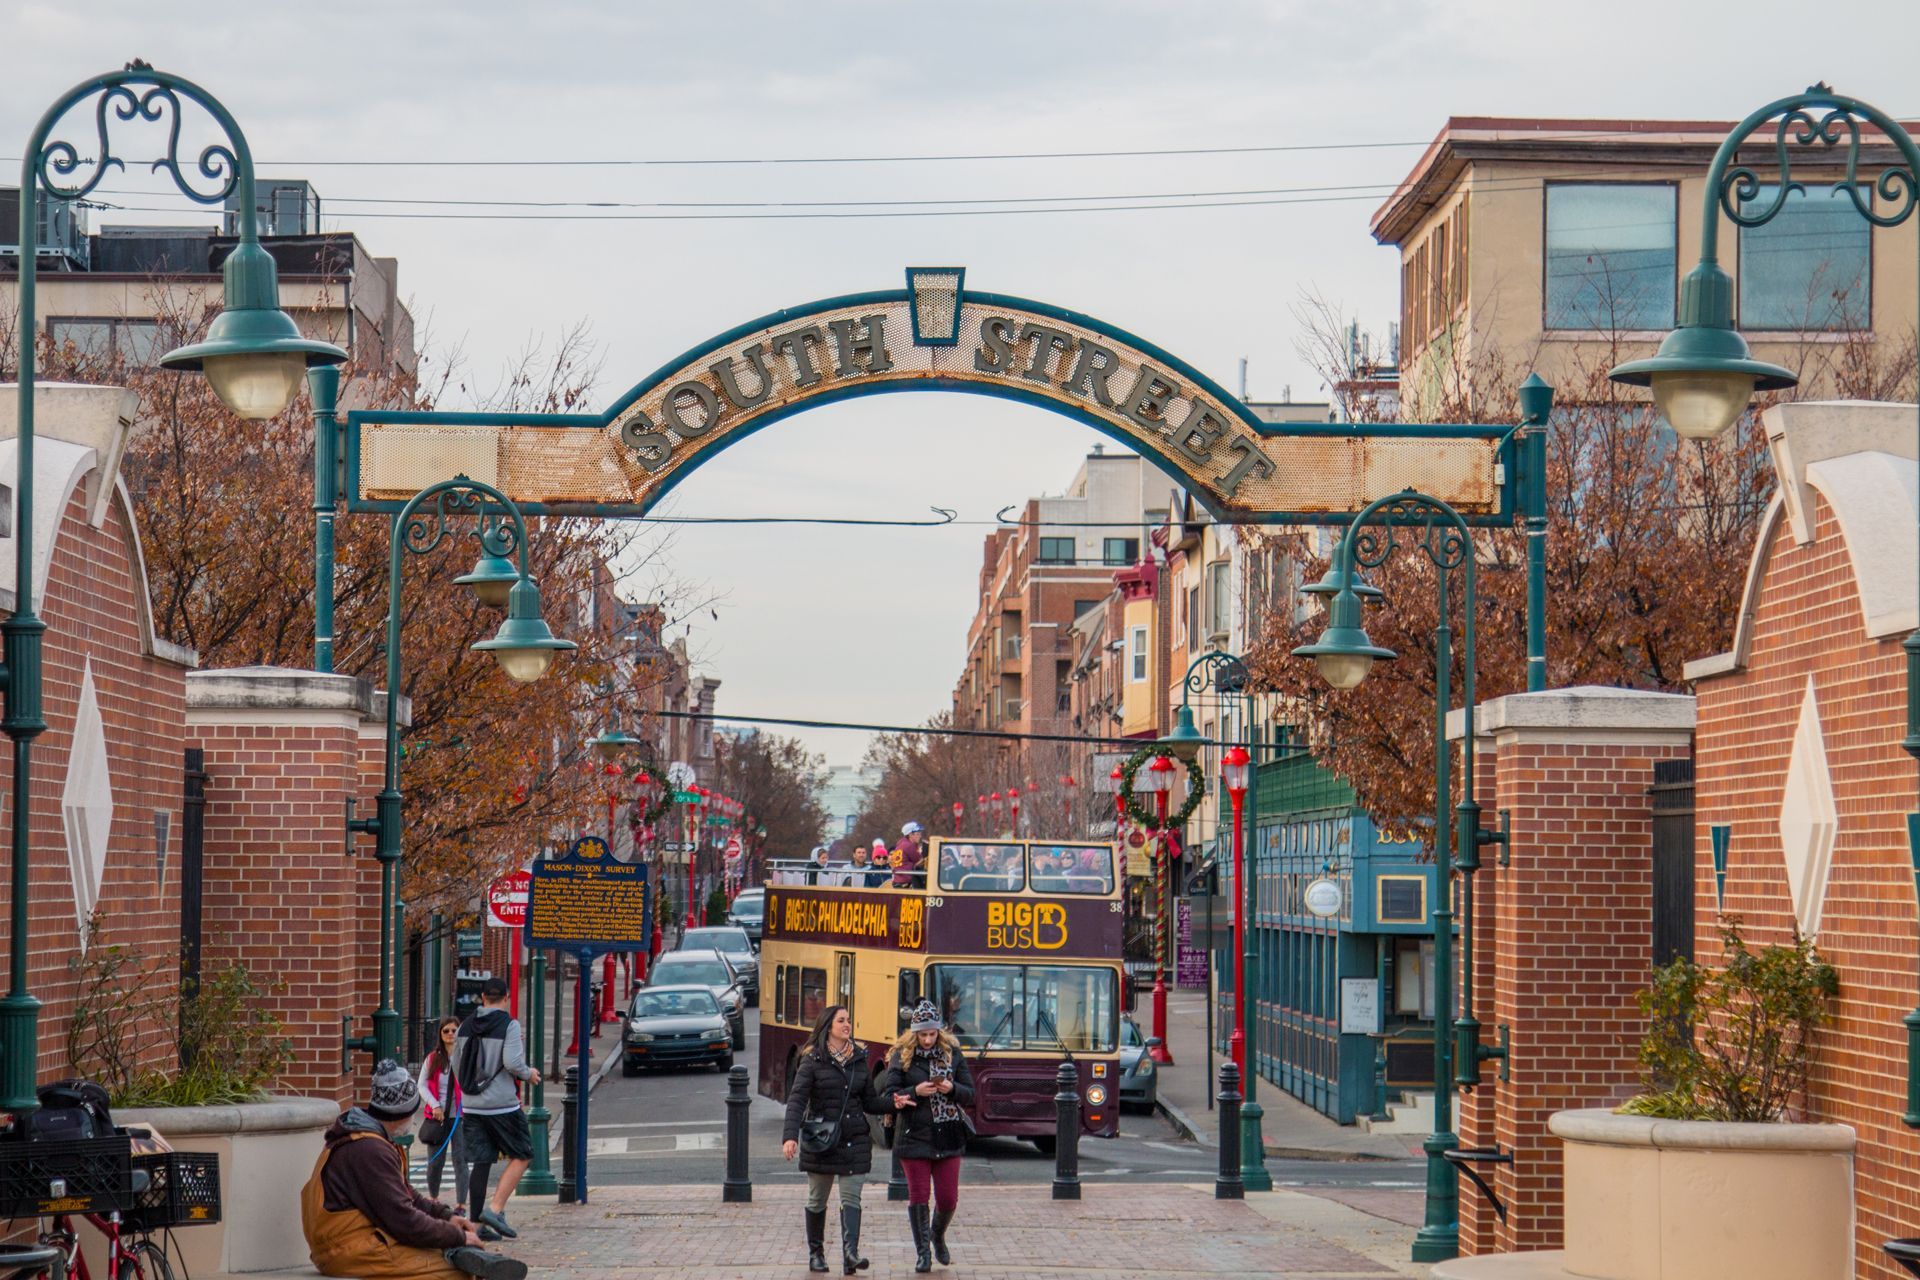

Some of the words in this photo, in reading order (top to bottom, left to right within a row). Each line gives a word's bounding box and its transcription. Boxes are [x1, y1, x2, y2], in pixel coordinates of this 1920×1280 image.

[621, 313, 894, 473] SOUTH
[973, 315, 1279, 498] STREET
[543, 864, 601, 872] MASON-DIXON
[605, 866, 636, 874] SURVEY
[500, 905, 525, 915] ENTE
[818, 901, 888, 937] PHILADELPHIA
[900, 898, 914, 923] BIG
[987, 902, 1032, 926] BIG
[987, 927, 1032, 949] BUS
